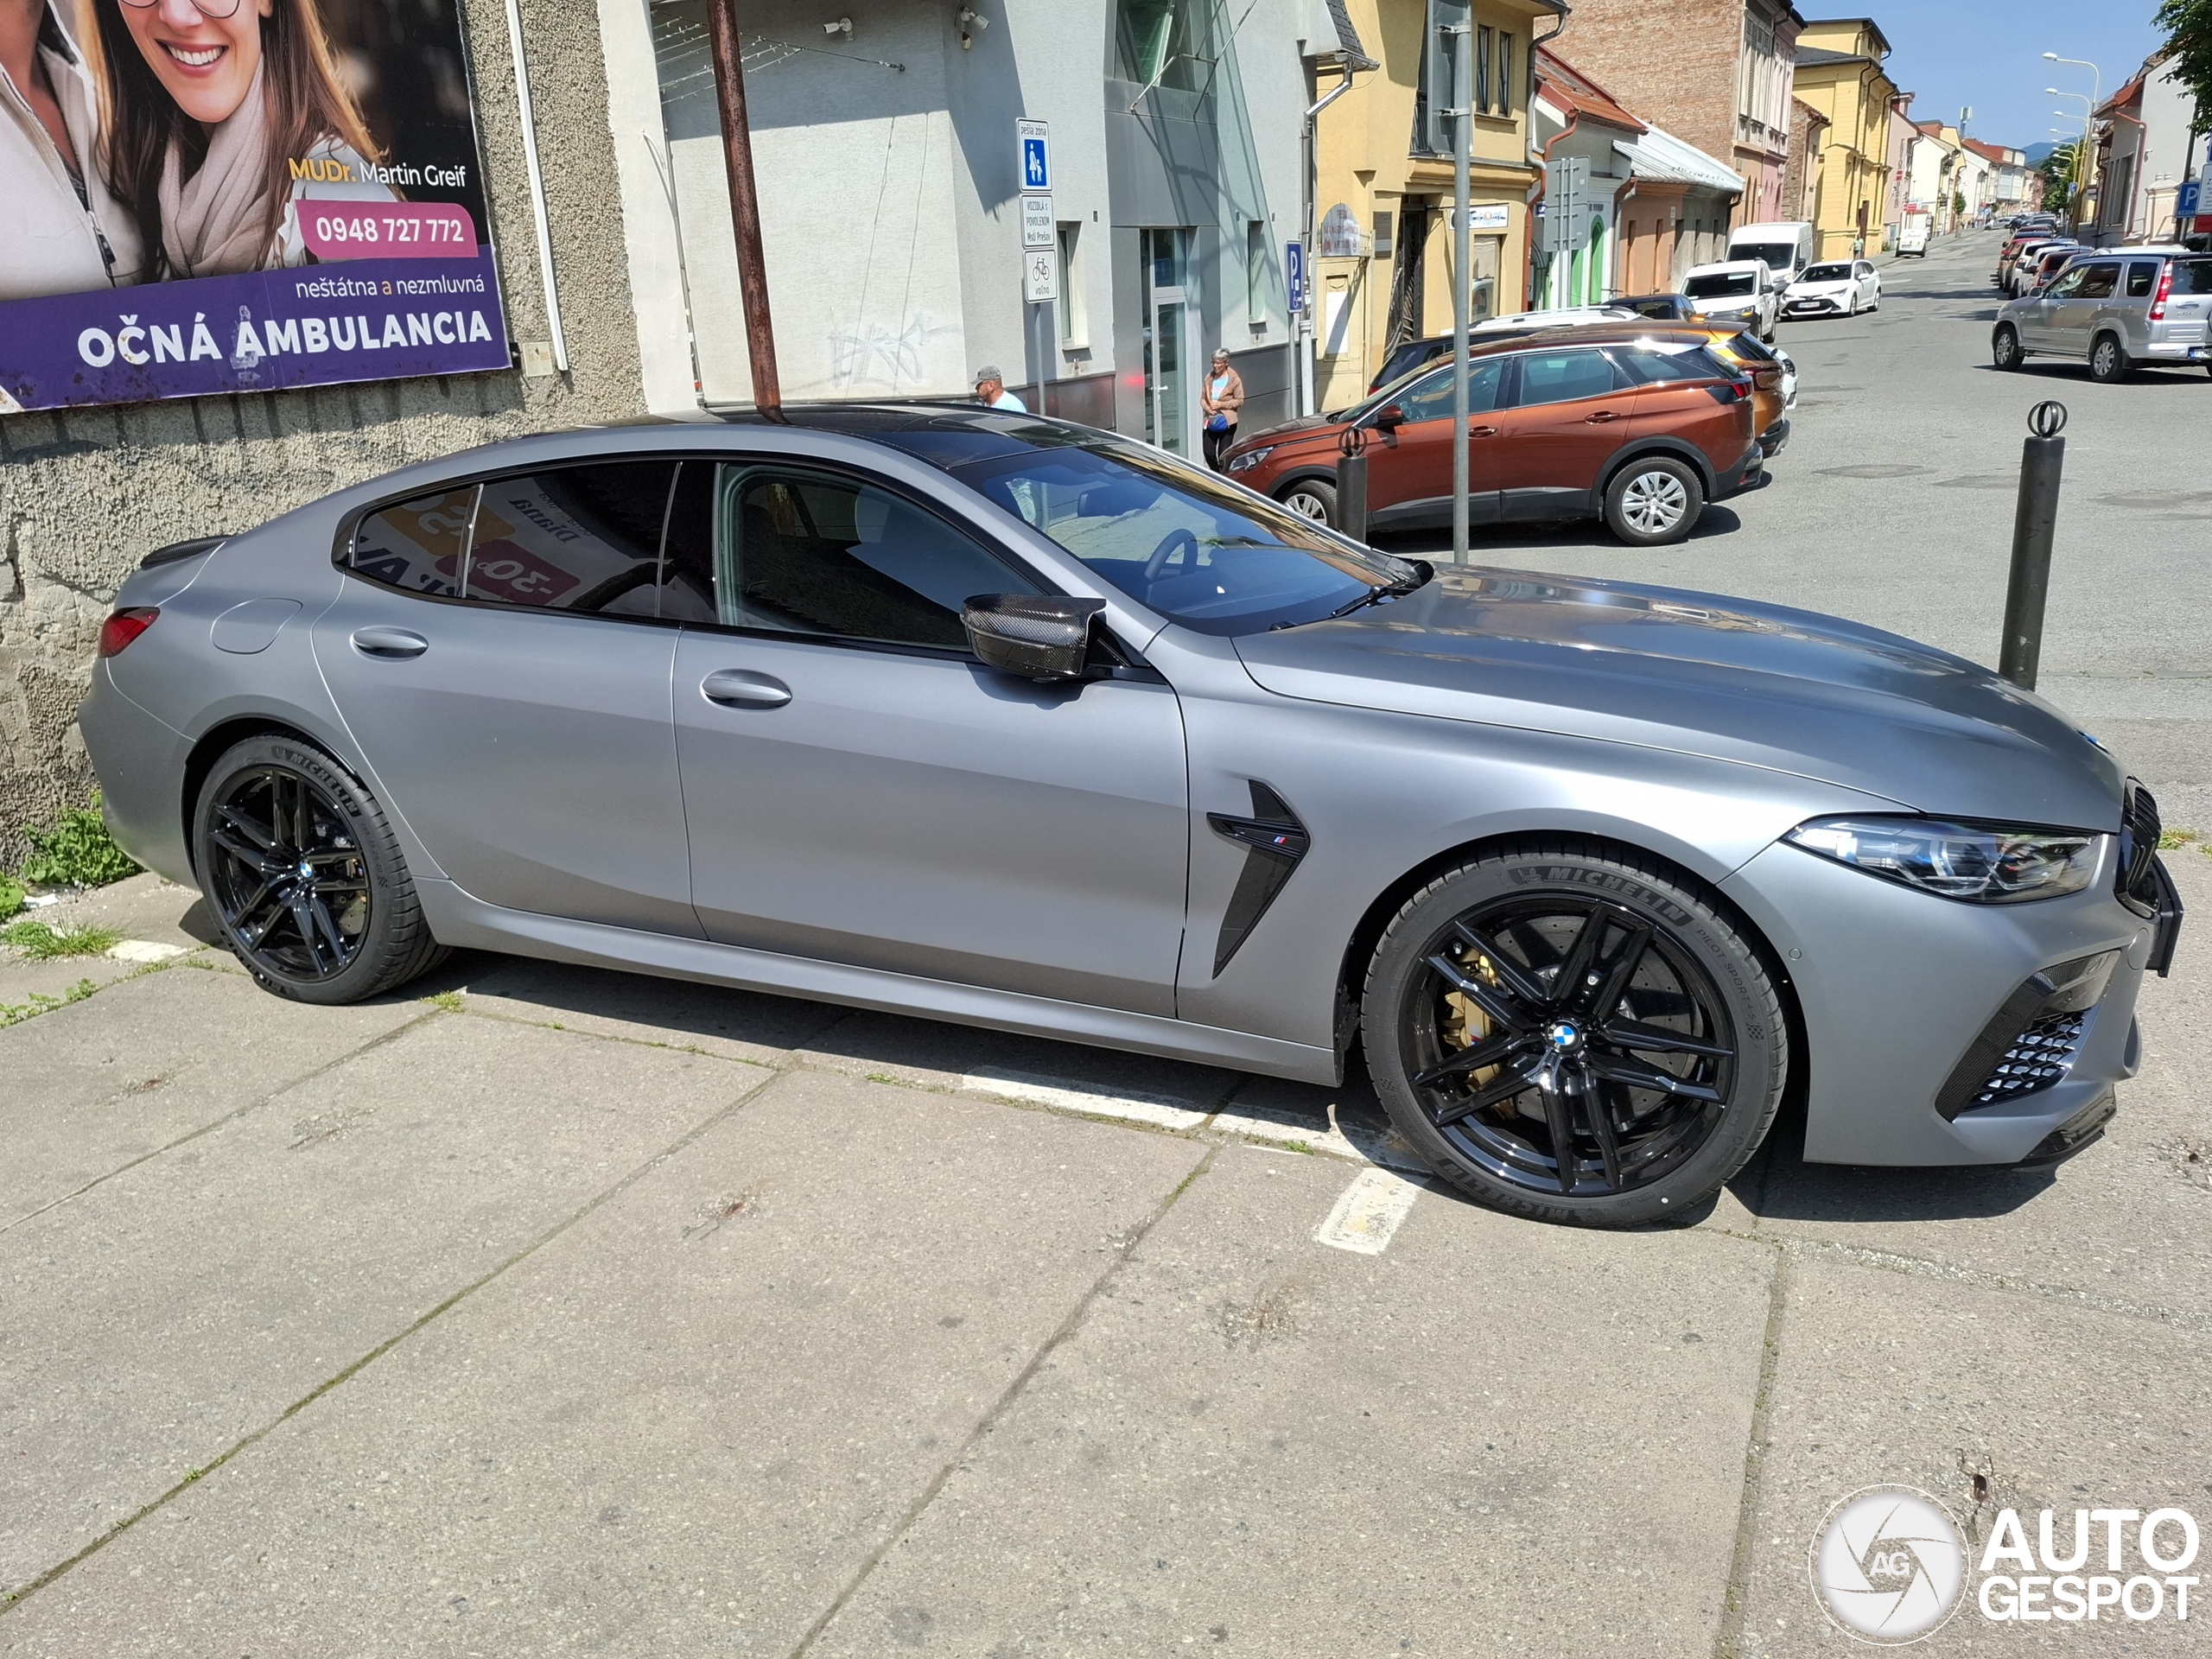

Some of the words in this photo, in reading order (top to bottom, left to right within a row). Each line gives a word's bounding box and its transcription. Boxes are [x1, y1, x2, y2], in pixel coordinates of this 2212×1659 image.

[288, 157, 357, 182] MUDr.
[359, 162, 422, 186] Martin
[424, 165, 467, 188] Greif
[1027, 199, 1045, 211] VOZIDLÁ
[2184, 187, 2198, 206] P
[316, 217, 379, 242] 0948
[383, 218, 420, 242] 727
[426, 219, 464, 242] 772
[1027, 213, 1050, 226] POVOLENÍM
[1037, 231, 1051, 242] Prešov
[1290, 251, 1298, 289] P
[296, 276, 378, 298] neštátna
[381, 280, 392, 296] a
[396, 274, 485, 296] nezmluvná
[78, 311, 223, 368] OČNÁ
[236, 310, 493, 357] AMBULANCIA
[290, 753, 359, 813] MICHELIN
[1547, 867, 1686, 922] MICHELIN
[1695, 929, 1726, 958] PILOT
[1724, 963, 1751, 1002] SPORT
[1445, 1163, 1569, 1221] MICHELIN
